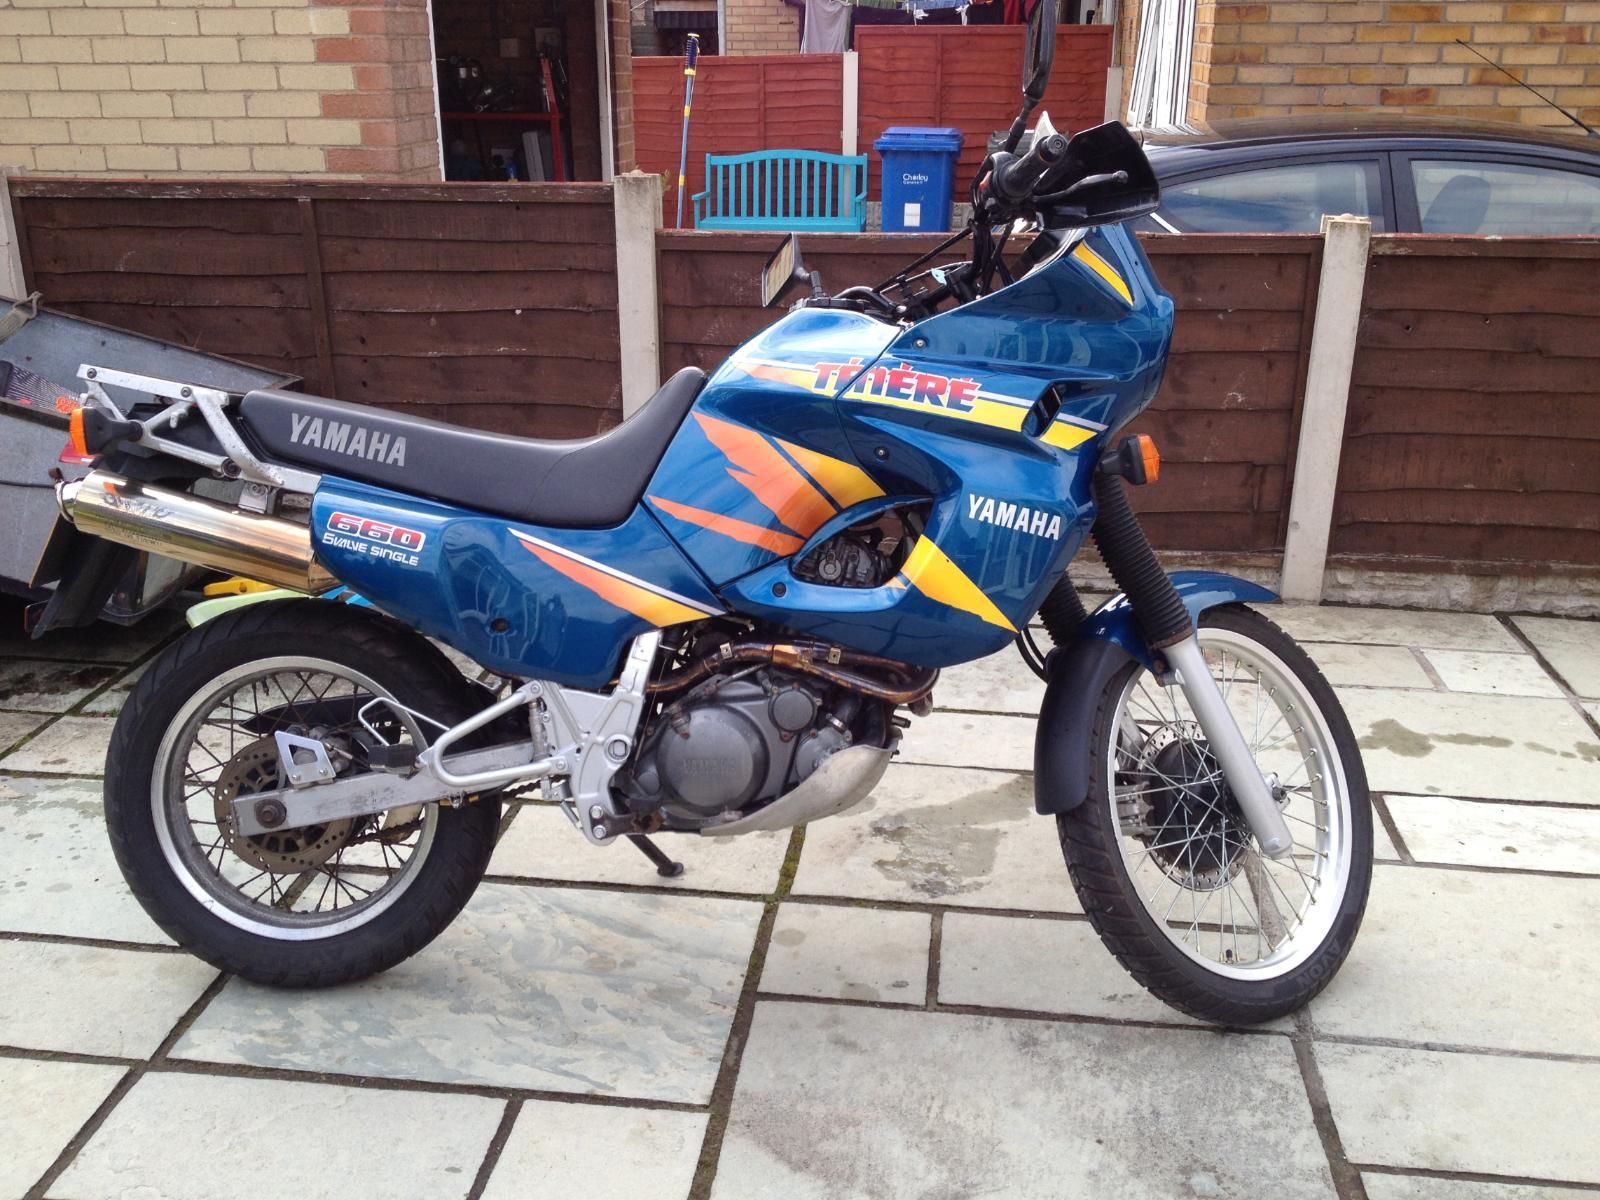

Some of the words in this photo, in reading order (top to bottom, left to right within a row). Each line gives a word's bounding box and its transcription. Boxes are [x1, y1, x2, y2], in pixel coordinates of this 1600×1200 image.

[289, 412, 407, 467] YAMAHA
[326, 511, 427, 553] 660
[968, 493, 1061, 541] YAMAHA
[369, 545, 419, 567] SINGLE
[1298, 939, 1341, 988] AVON
